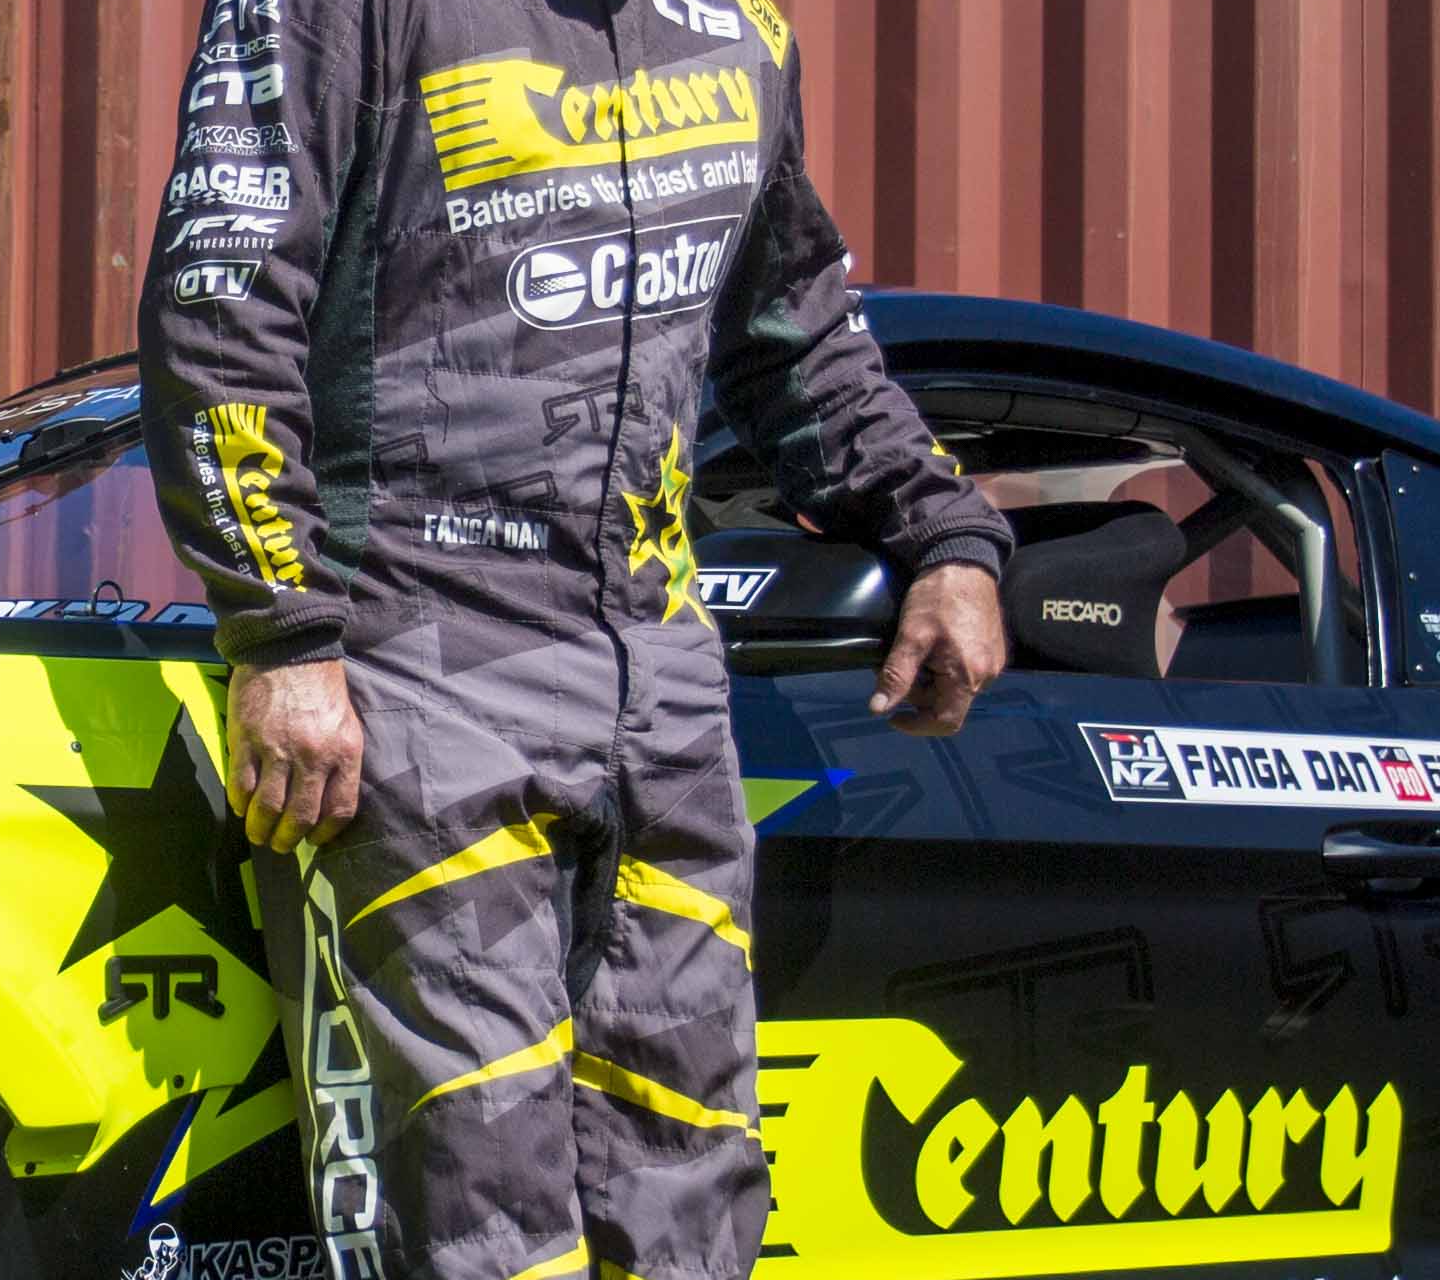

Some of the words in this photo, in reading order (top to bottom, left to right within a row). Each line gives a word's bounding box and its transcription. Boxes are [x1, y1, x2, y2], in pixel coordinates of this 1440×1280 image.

[189, 64, 283, 113] CTB
[199, 122, 293, 149] KASPA
[420, 59, 760, 192] Century
[169, 164, 290, 202] RACER
[232, 193, 287, 207] PRODUCTS
[446, 180, 592, 234] Batteries
[654, 158, 698, 193] last
[702, 152, 740, 188] and
[165, 214, 286, 253] JFK
[189, 236, 274, 250] POWERSPORTS
[180, 266, 250, 298] OTV
[591, 227, 732, 309] Castrol
[194, 409, 216, 487] Batteries
[206, 488, 233, 532] that
[220, 524, 249, 560] last
[208, 402, 307, 593] Centur
[424, 513, 496, 547] FANGA
[504, 519, 550, 551] DAN
[699, 574, 756, 602] TV
[1042, 599, 1122, 627] RECARO
[1112, 761, 1170, 788] NZ
[1176, 743, 1302, 791] FANGA
[1302, 749, 1382, 794] DAN
[1388, 763, 1426, 797] PRO
